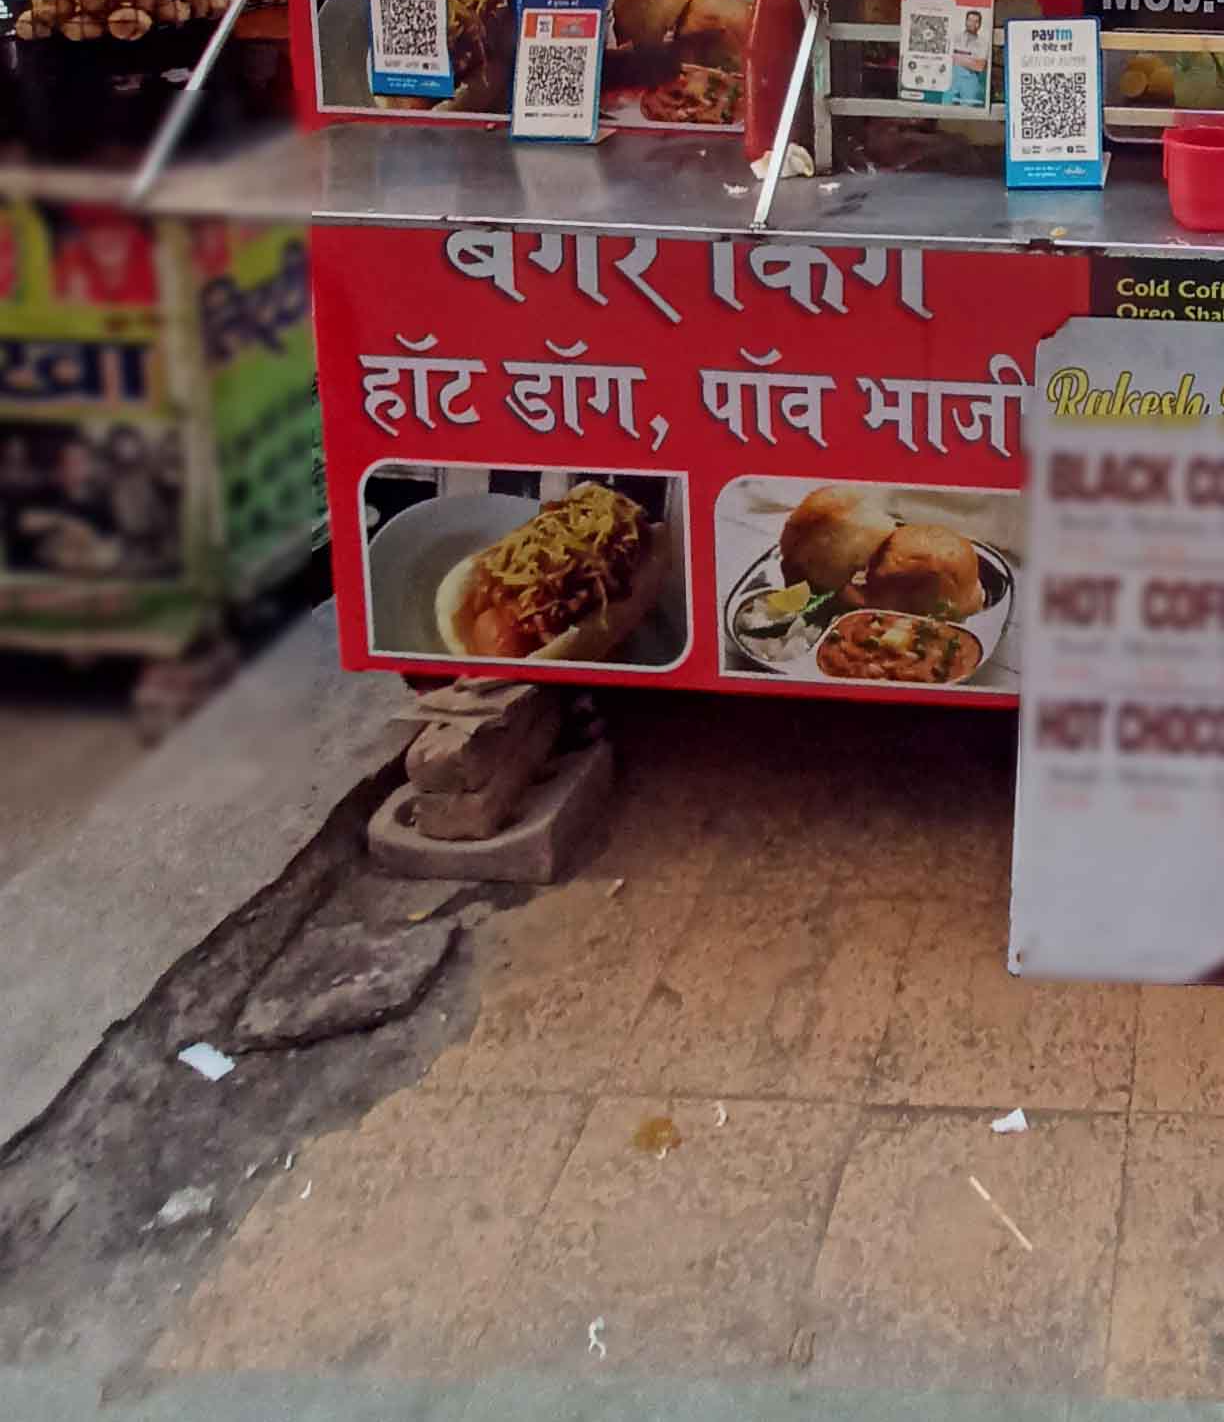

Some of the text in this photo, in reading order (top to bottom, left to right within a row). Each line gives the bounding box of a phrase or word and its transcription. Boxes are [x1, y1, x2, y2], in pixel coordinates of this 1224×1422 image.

[1116, 277, 1170, 299] Cold
[359, 333, 488, 437] हॉट
[700, 347, 837, 448] पॉव
[857, 353, 1036, 459] भाजी
[1046, 367, 1210, 426] Rakesh
